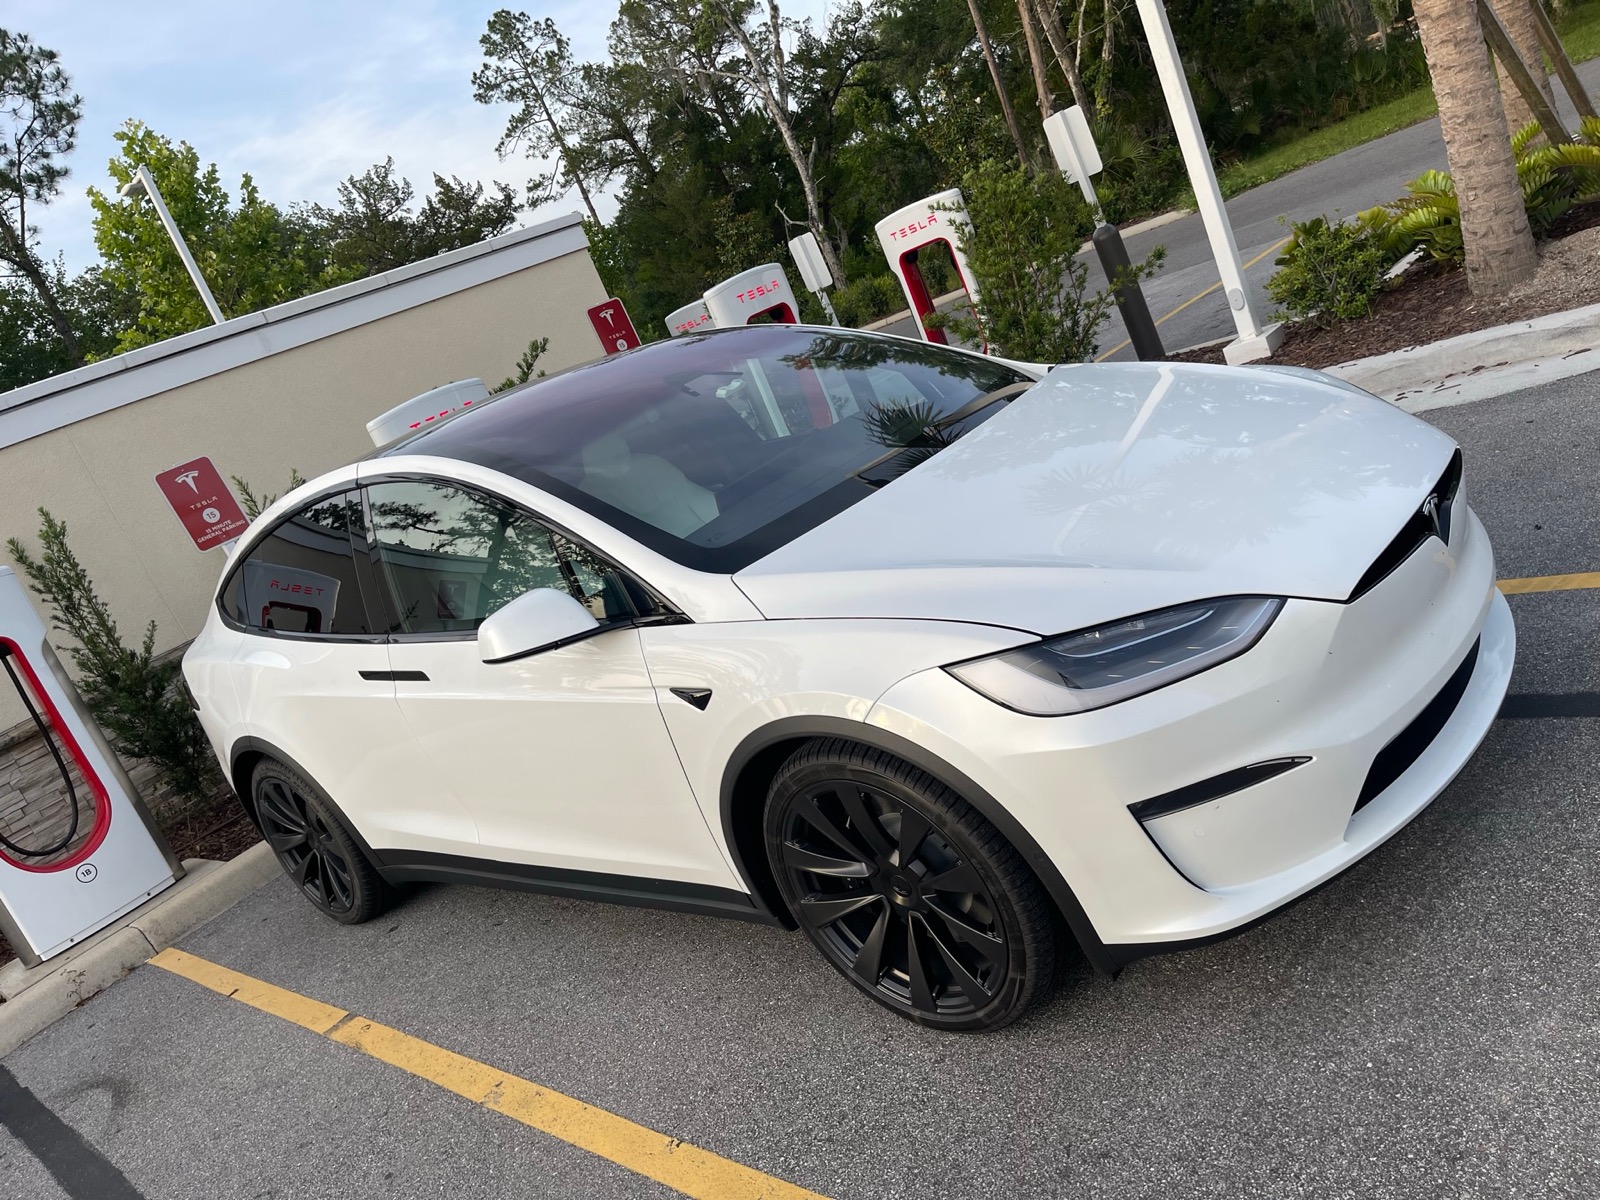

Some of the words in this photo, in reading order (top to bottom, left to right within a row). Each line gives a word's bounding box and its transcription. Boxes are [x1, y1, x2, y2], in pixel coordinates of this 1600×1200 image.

[890, 214, 938, 241] TESLA
[736, 280, 780, 303] TESLA
[675, 314, 709, 333] TESLA
[190, 495, 218, 510] TESLA
[206, 511, 217, 519] 15
[197, 530, 223, 543] GENERAL
[222, 519, 246, 532] PARKING
[211, 519, 232, 531] MINUTE
[81, 868, 92, 877] 1B
